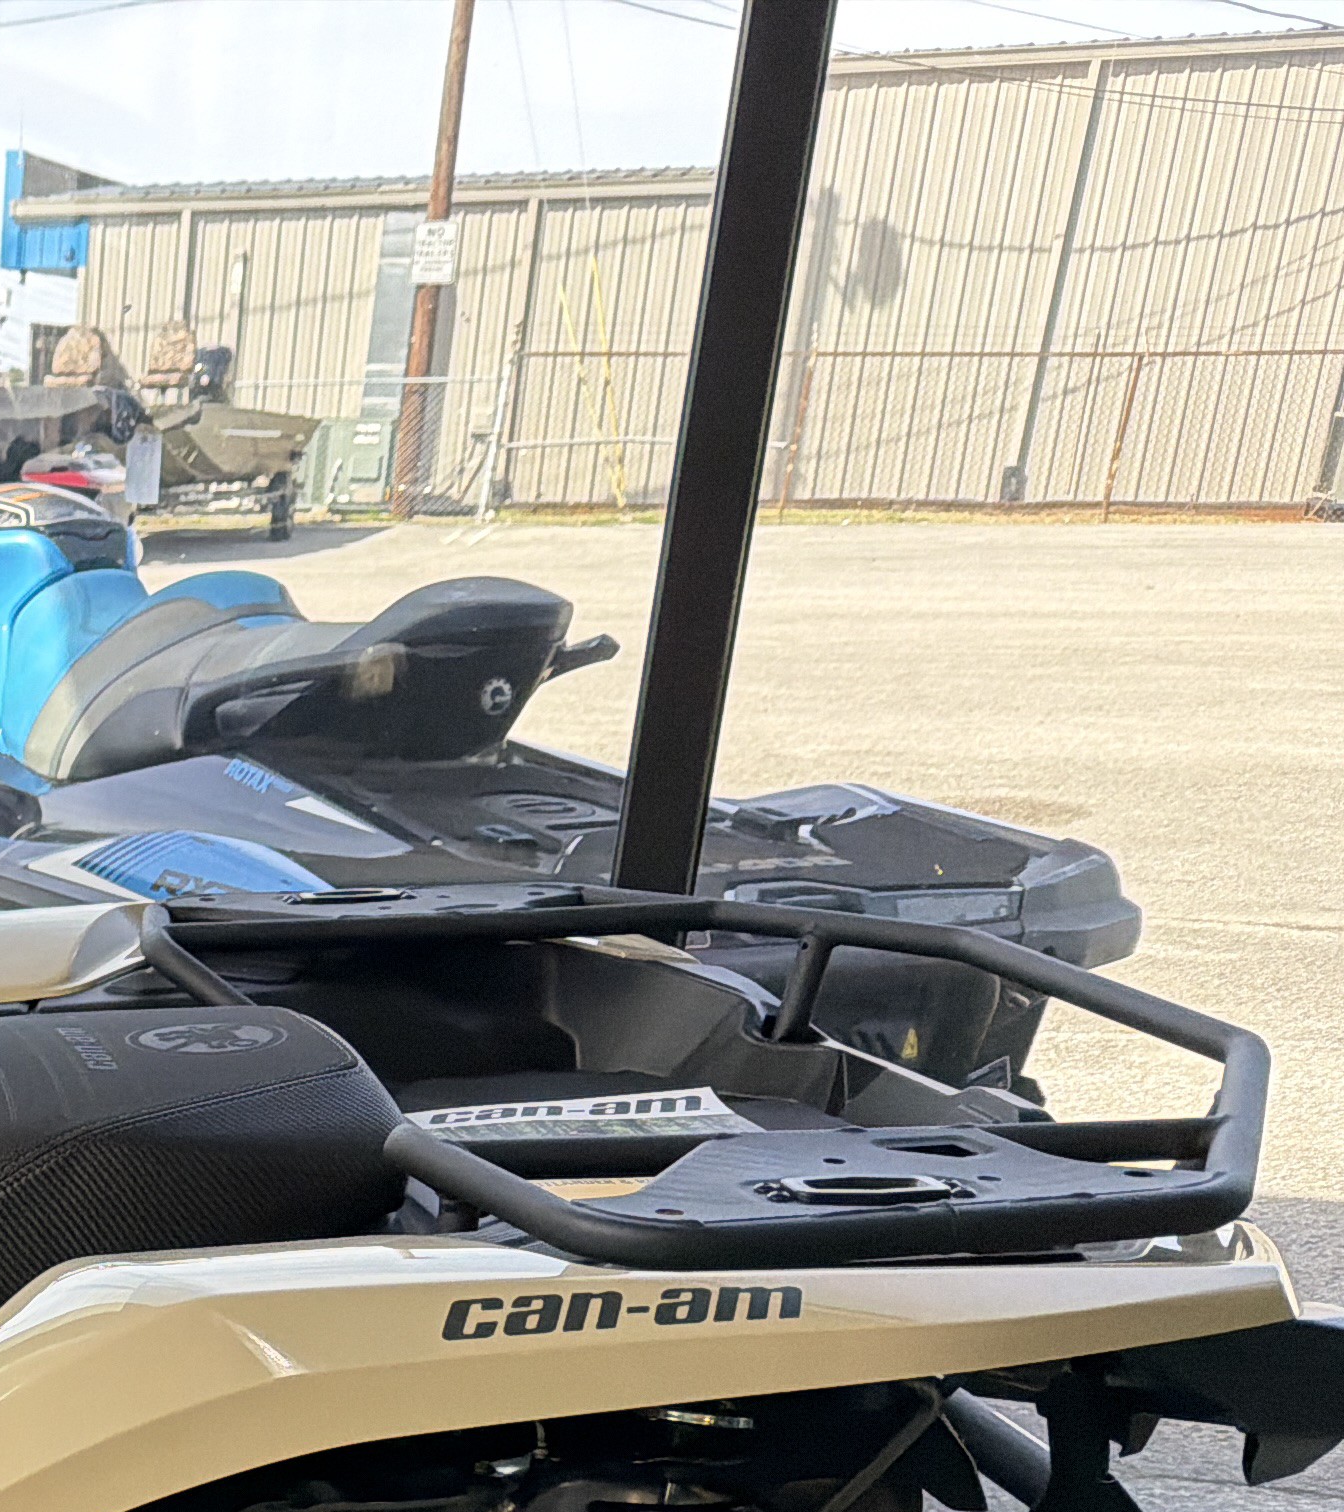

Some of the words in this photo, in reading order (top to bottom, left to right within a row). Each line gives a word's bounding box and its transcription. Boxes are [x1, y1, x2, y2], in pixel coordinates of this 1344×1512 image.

[223, 757, 275, 794] ROTAX
[428, 1094, 704, 1126] can-am
[441, 1285, 804, 1342] can-am
